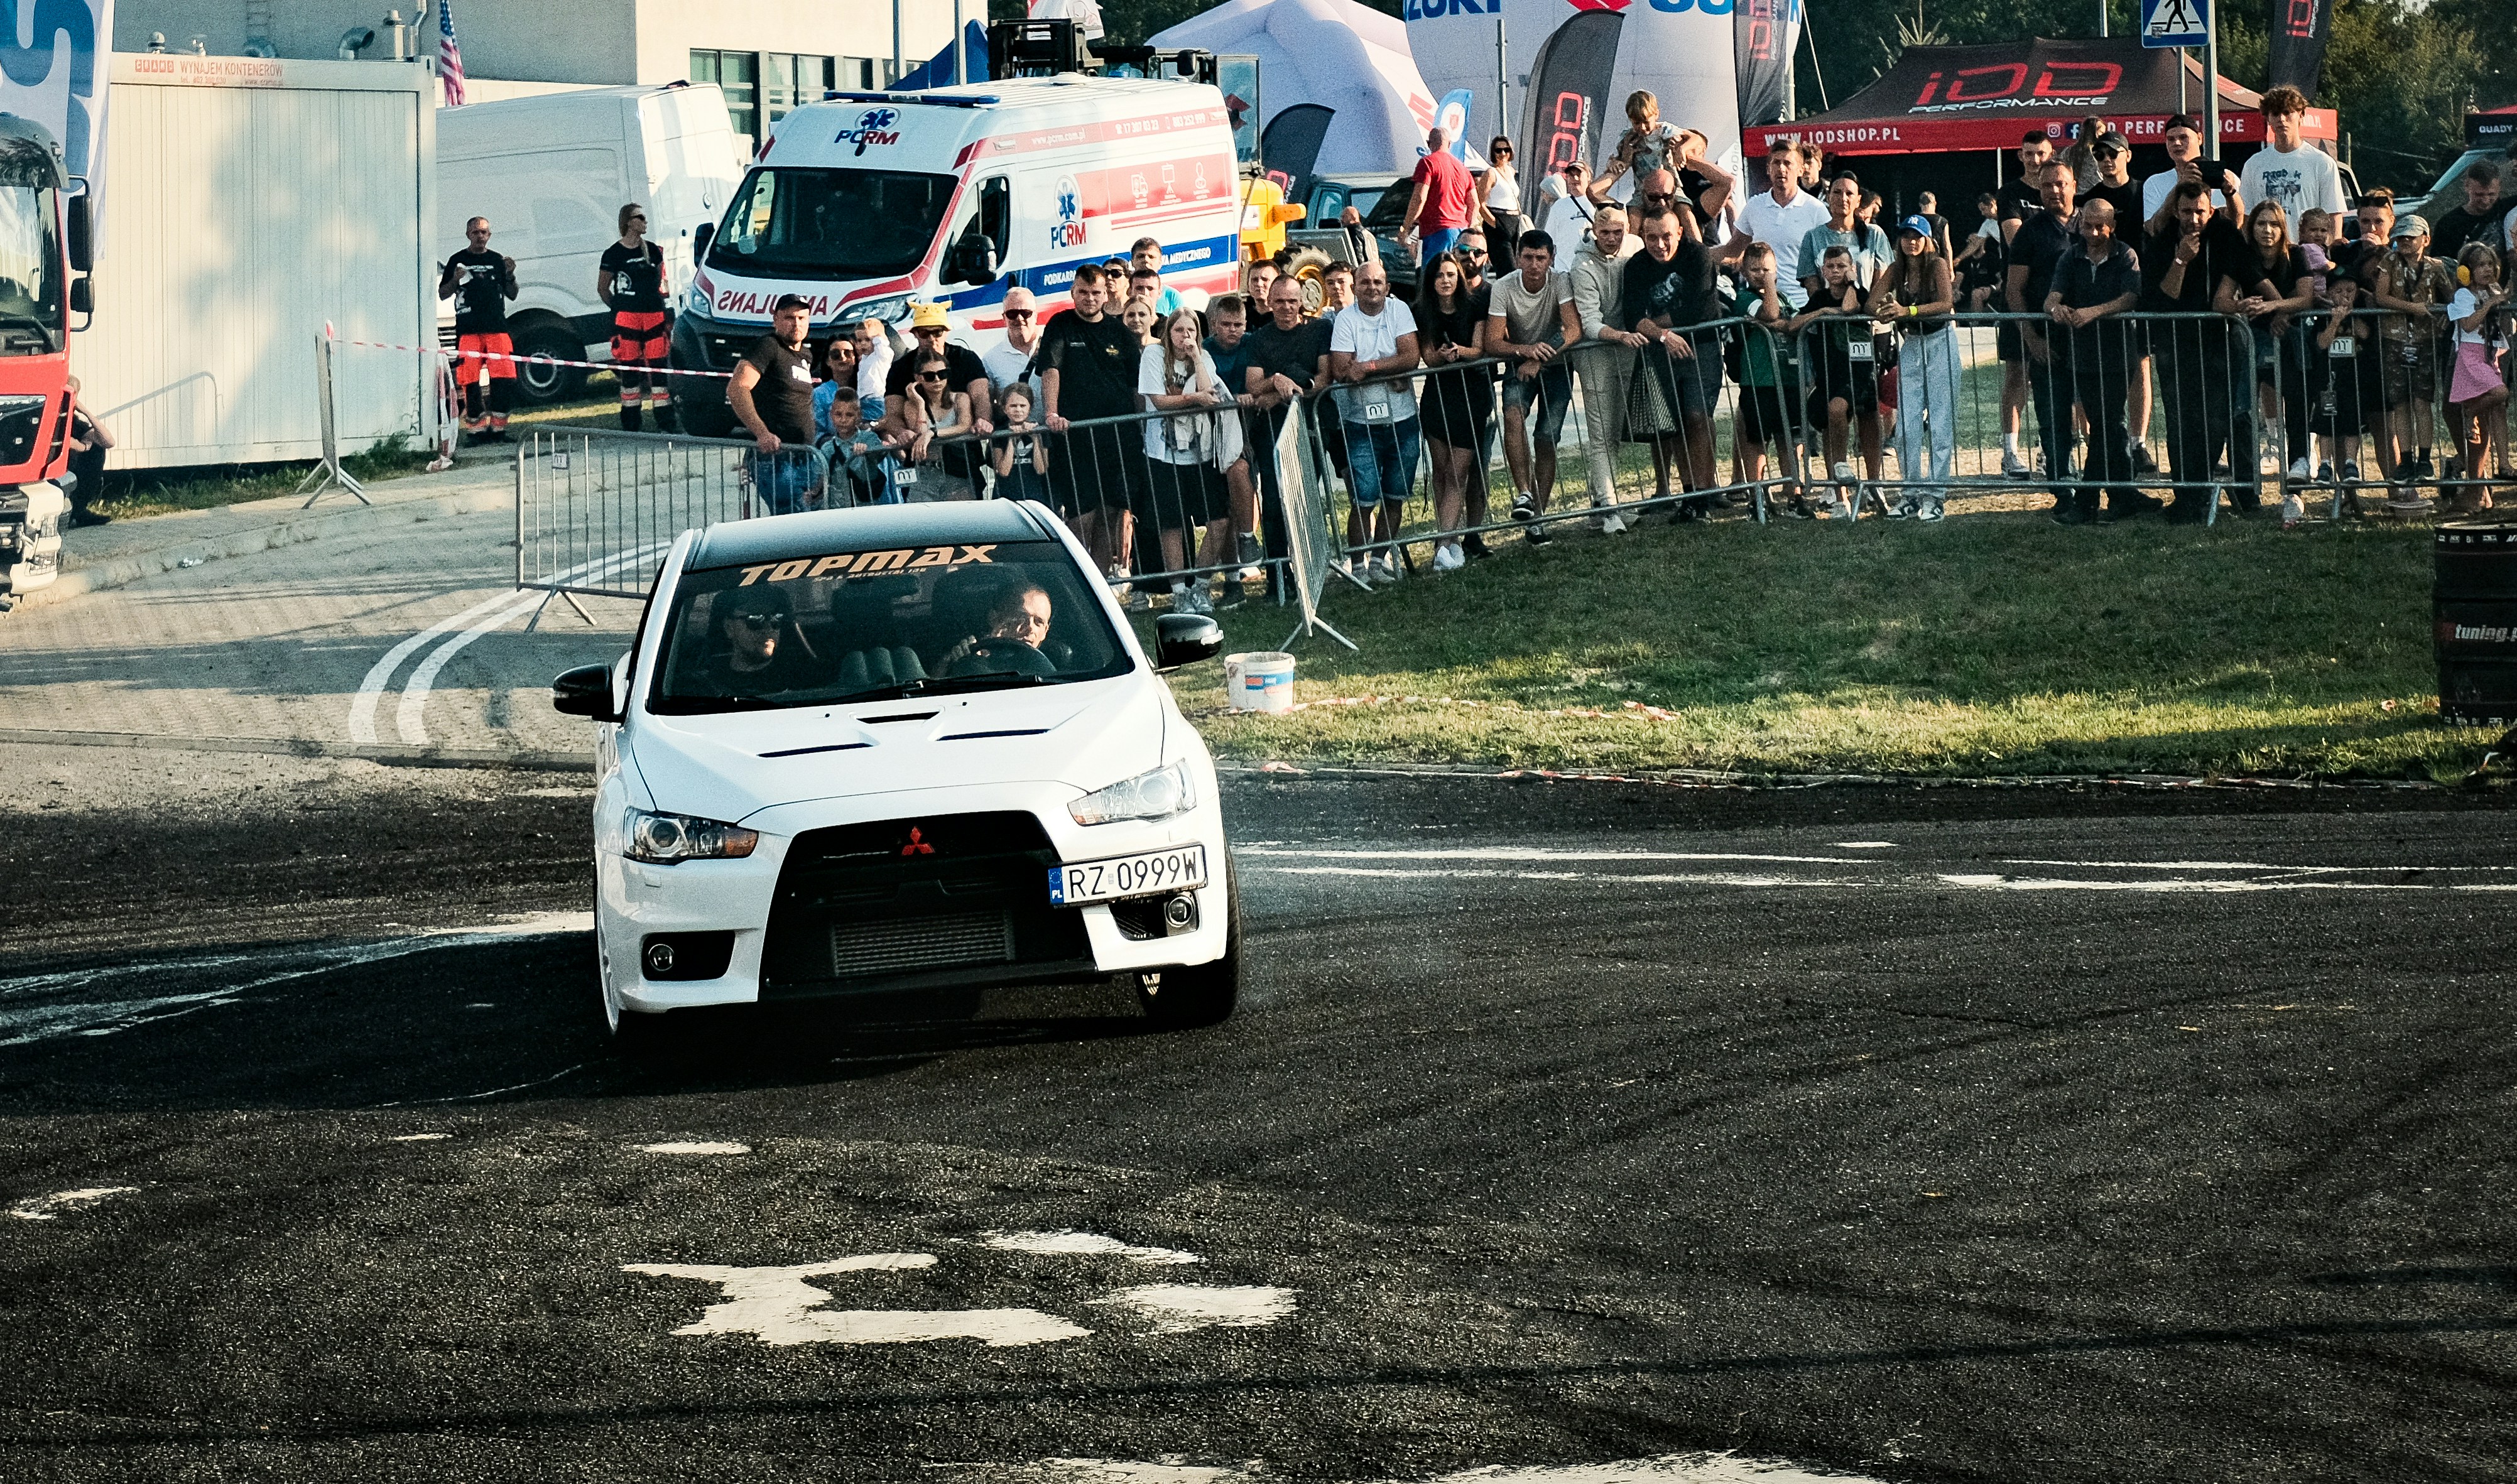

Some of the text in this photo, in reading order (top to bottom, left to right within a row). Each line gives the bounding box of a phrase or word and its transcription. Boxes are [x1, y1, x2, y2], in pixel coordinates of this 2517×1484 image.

[180, 60, 283, 77] WYNAJEM KONTENERÓW
[1908, 97, 2108, 114] PERFORMANCE
[1578, 96, 1592, 162] FORMANCE
[2125, 119, 2244, 134] PERFCE
[2479, 124, 2513, 133] QUADY
[834, 129, 900, 145] PCRM
[2262, 168, 2302, 180] Reebk
[1051, 222, 1087, 249] PCRM
[739, 544, 998, 587] TOPMAX
[1068, 865, 1106, 898] RZ
[1117, 851, 1197, 891] 0999W
[1052, 890, 1063, 899] PL
